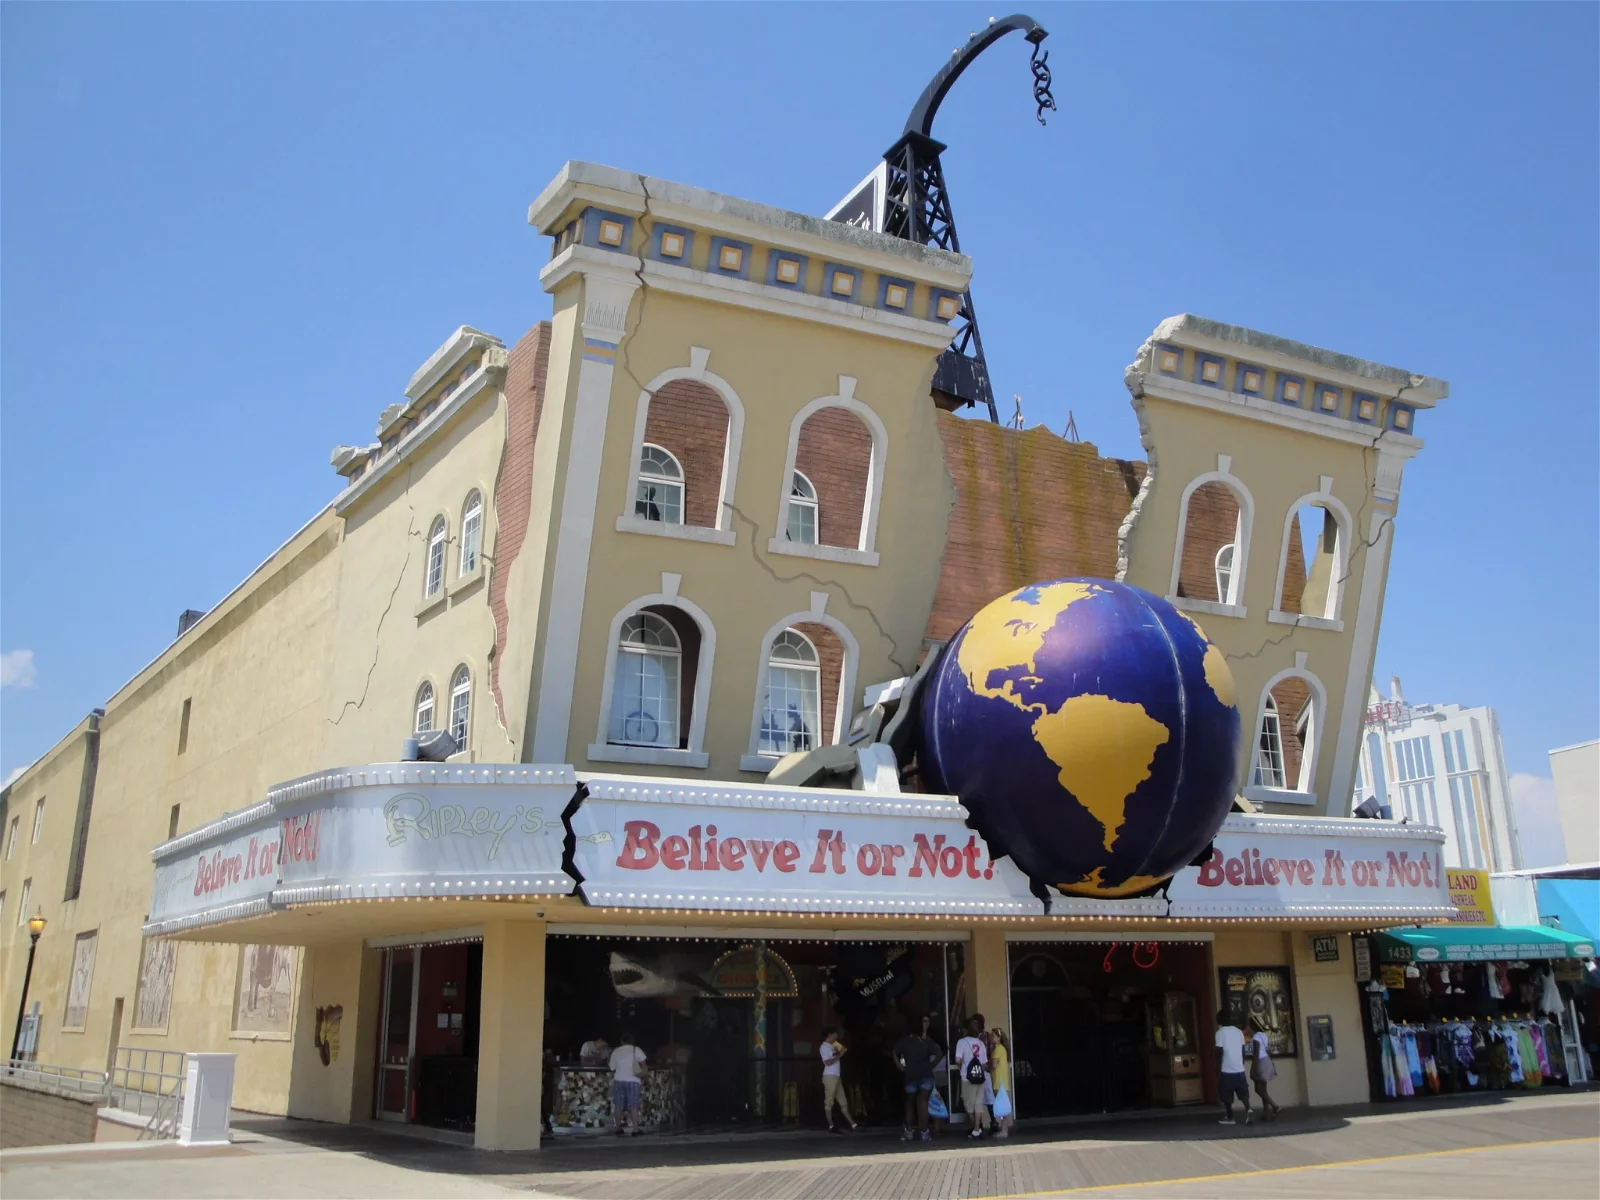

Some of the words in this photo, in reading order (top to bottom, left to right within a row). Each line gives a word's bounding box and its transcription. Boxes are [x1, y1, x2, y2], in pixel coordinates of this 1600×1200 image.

[193, 850, 243, 896] Believe
[244, 836, 259, 880] It
[260, 840, 279, 876] or
[281, 810, 322, 865] Not!
[615, 820, 801, 873] Believe
[808, 829, 847, 874] It
[857, 843, 905, 876] or
[1197, 847, 1316, 887] Believe
[1322, 849, 1346, 886] It
[1351, 860, 1383, 887] or
[1385, 850, 1440, 888] Not!
[1447, 874, 1478, 890] LAND
[1315, 937, 1337, 952] ATM
[1388, 946, 1412, 959] 1433
